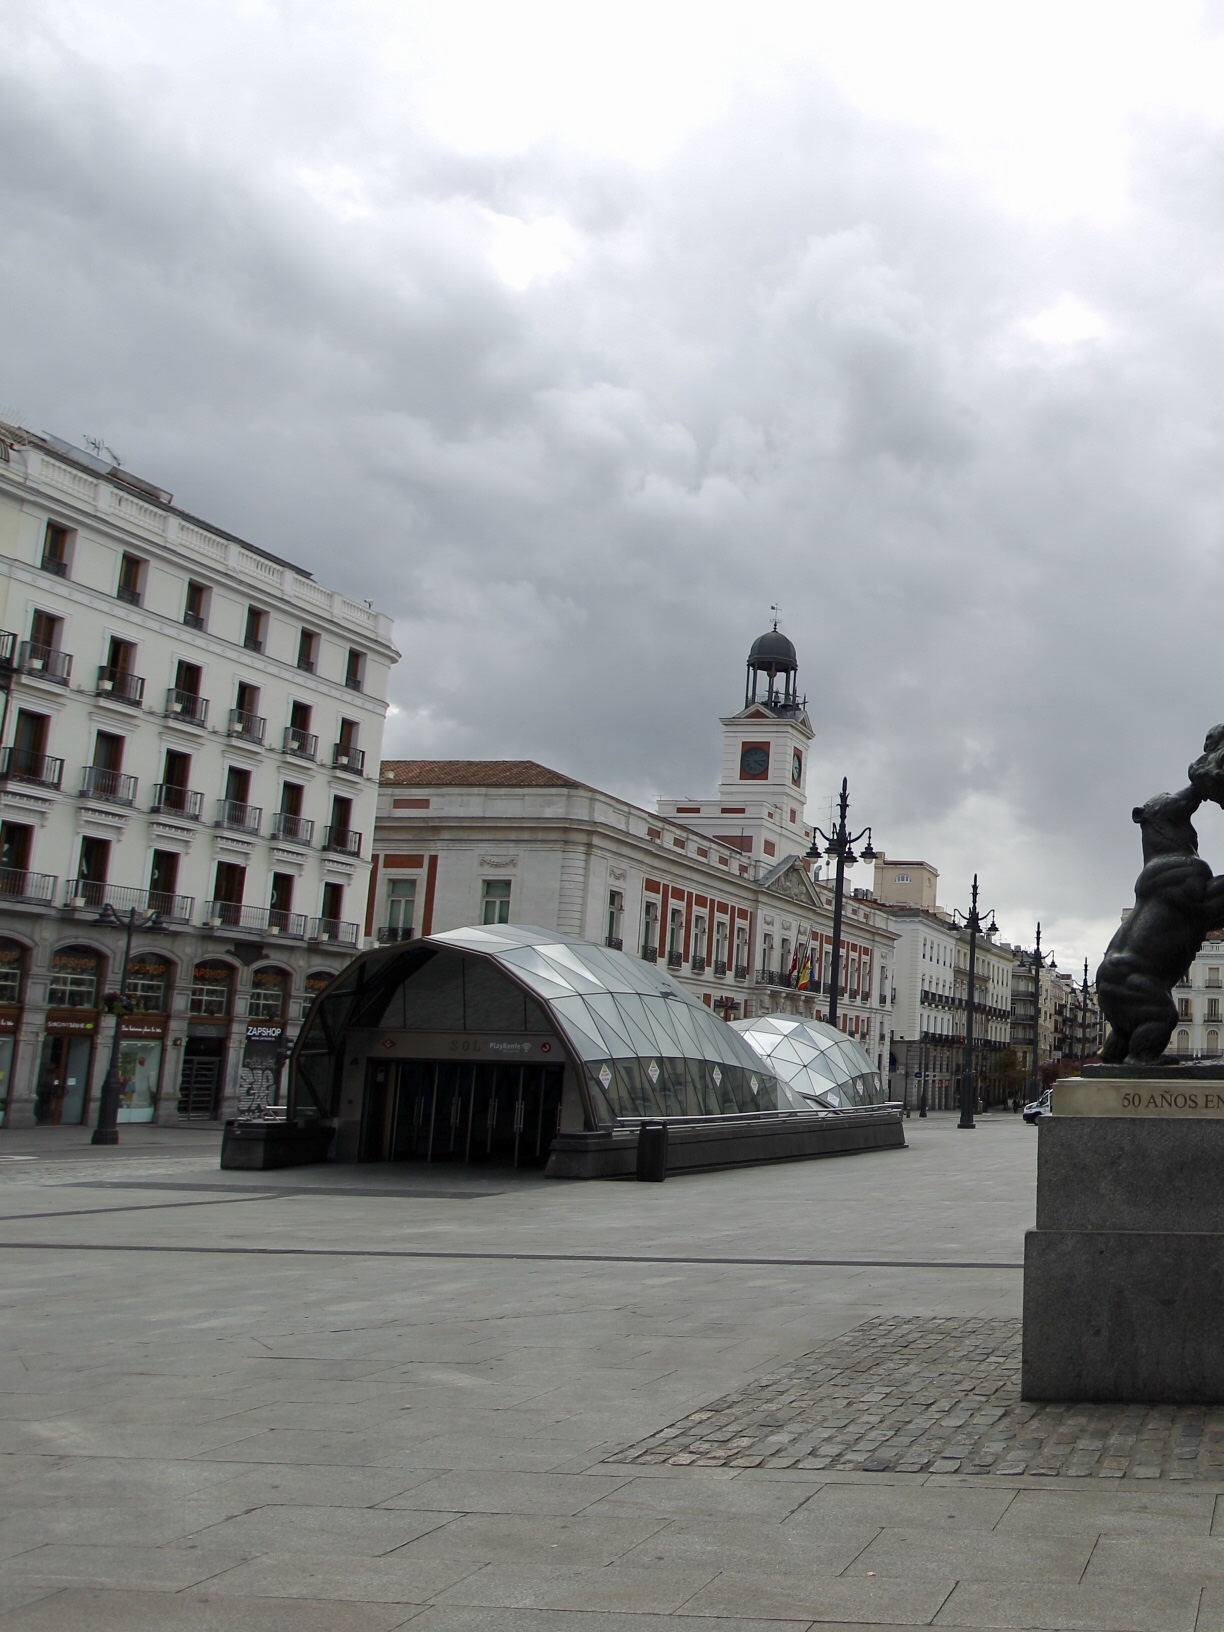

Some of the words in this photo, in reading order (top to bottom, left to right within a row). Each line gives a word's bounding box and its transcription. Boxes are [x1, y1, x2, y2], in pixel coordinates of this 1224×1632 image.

[247, 1026, 282, 1038] ZAPSHOP
[450, 1040, 481, 1052] SOL
[489, 1042, 521, 1052] PlayRenfe
[1121, 1093, 1141, 1108] 50
[1145, 1090, 1198, 1110] AÑOS
